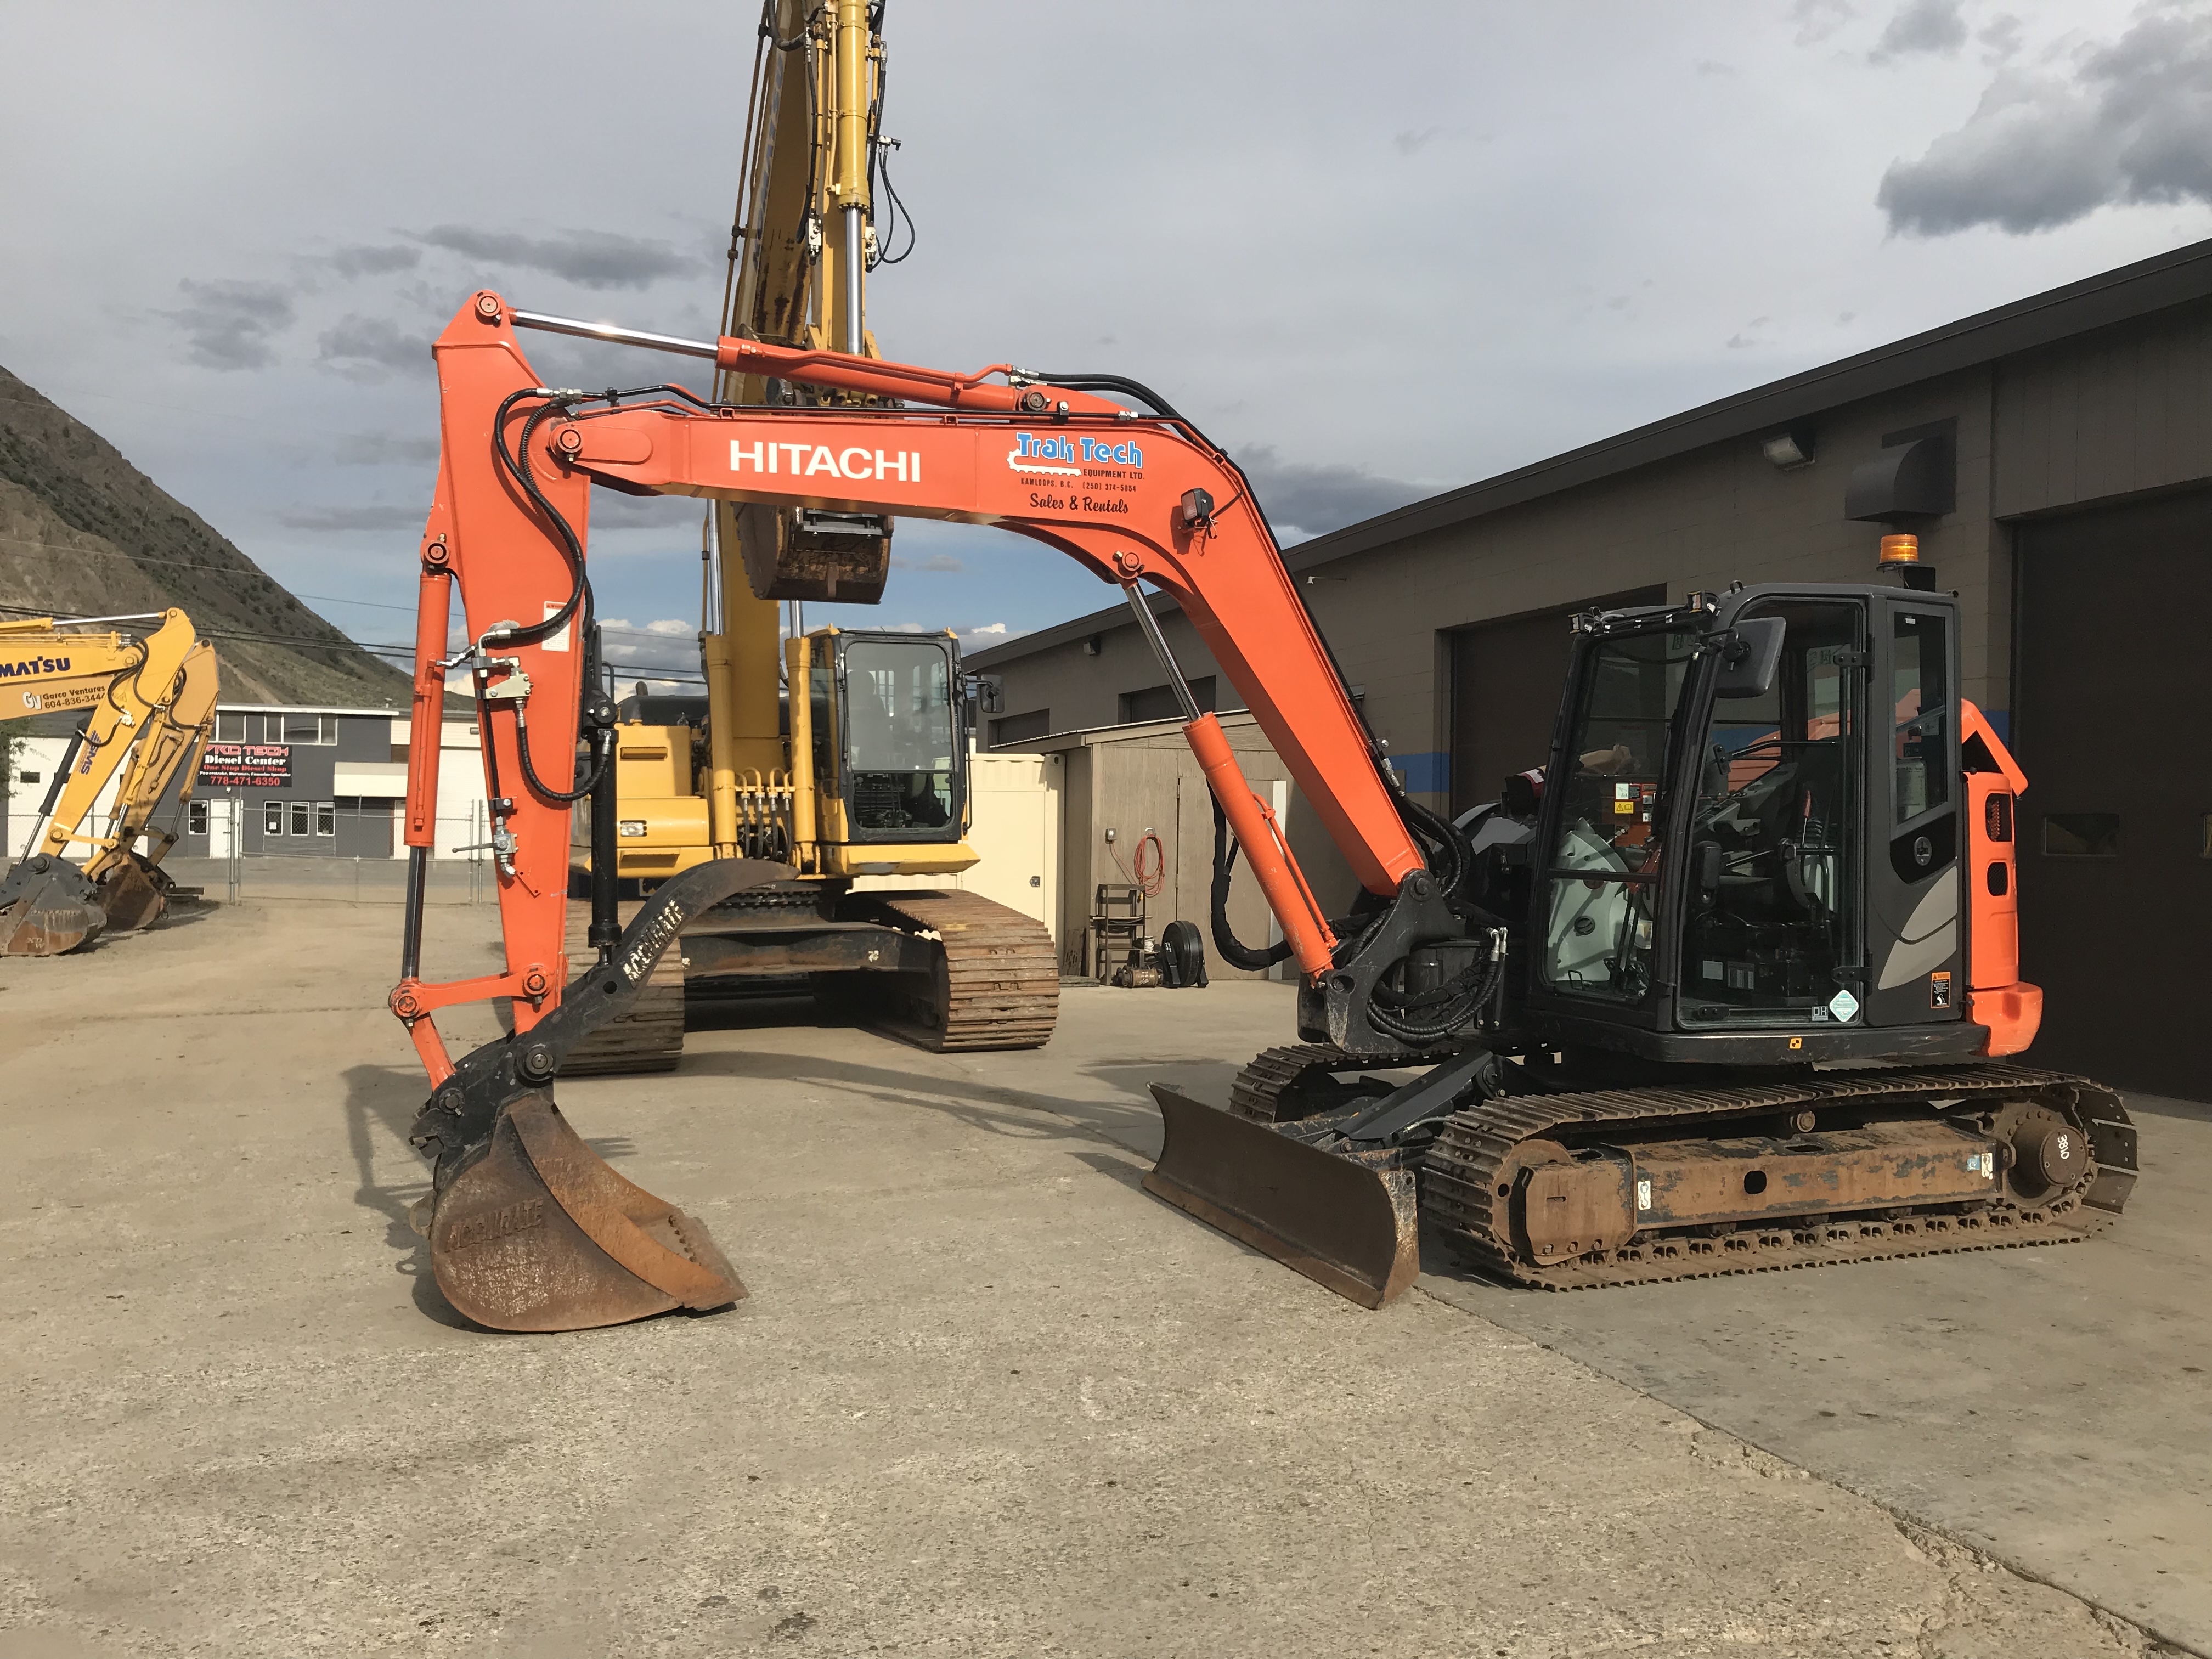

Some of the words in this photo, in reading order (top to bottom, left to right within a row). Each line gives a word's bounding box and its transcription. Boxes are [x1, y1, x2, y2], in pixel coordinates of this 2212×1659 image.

[1016, 432, 1075, 464] Trak
[1080, 437, 1143, 469] Tech
[730, 439, 921, 482] HITACHI
[1083, 469, 1127, 478] EQUIPMENT
[1130, 471, 1145, 480] LTD.
[1021, 478, 1057, 488] KAMLOOPS,
[1082, 481, 1102, 490] (250)
[1105, 483, 1136, 492] 374-5054
[1030, 493, 1064, 510] Sales
[1069, 495, 1079, 511] &
[1082, 496, 1128, 514] Rentals
[43, 692, 67, 700] Garco
[69, 686, 105, 696] Ventures
[243, 745, 289, 757] TECH
[205, 755, 242, 764] Diesel
[245, 756, 286, 765] Center
[210, 776, 280, 786] 778-471-6350
[2057, 1134, 2069, 1159] 3810
